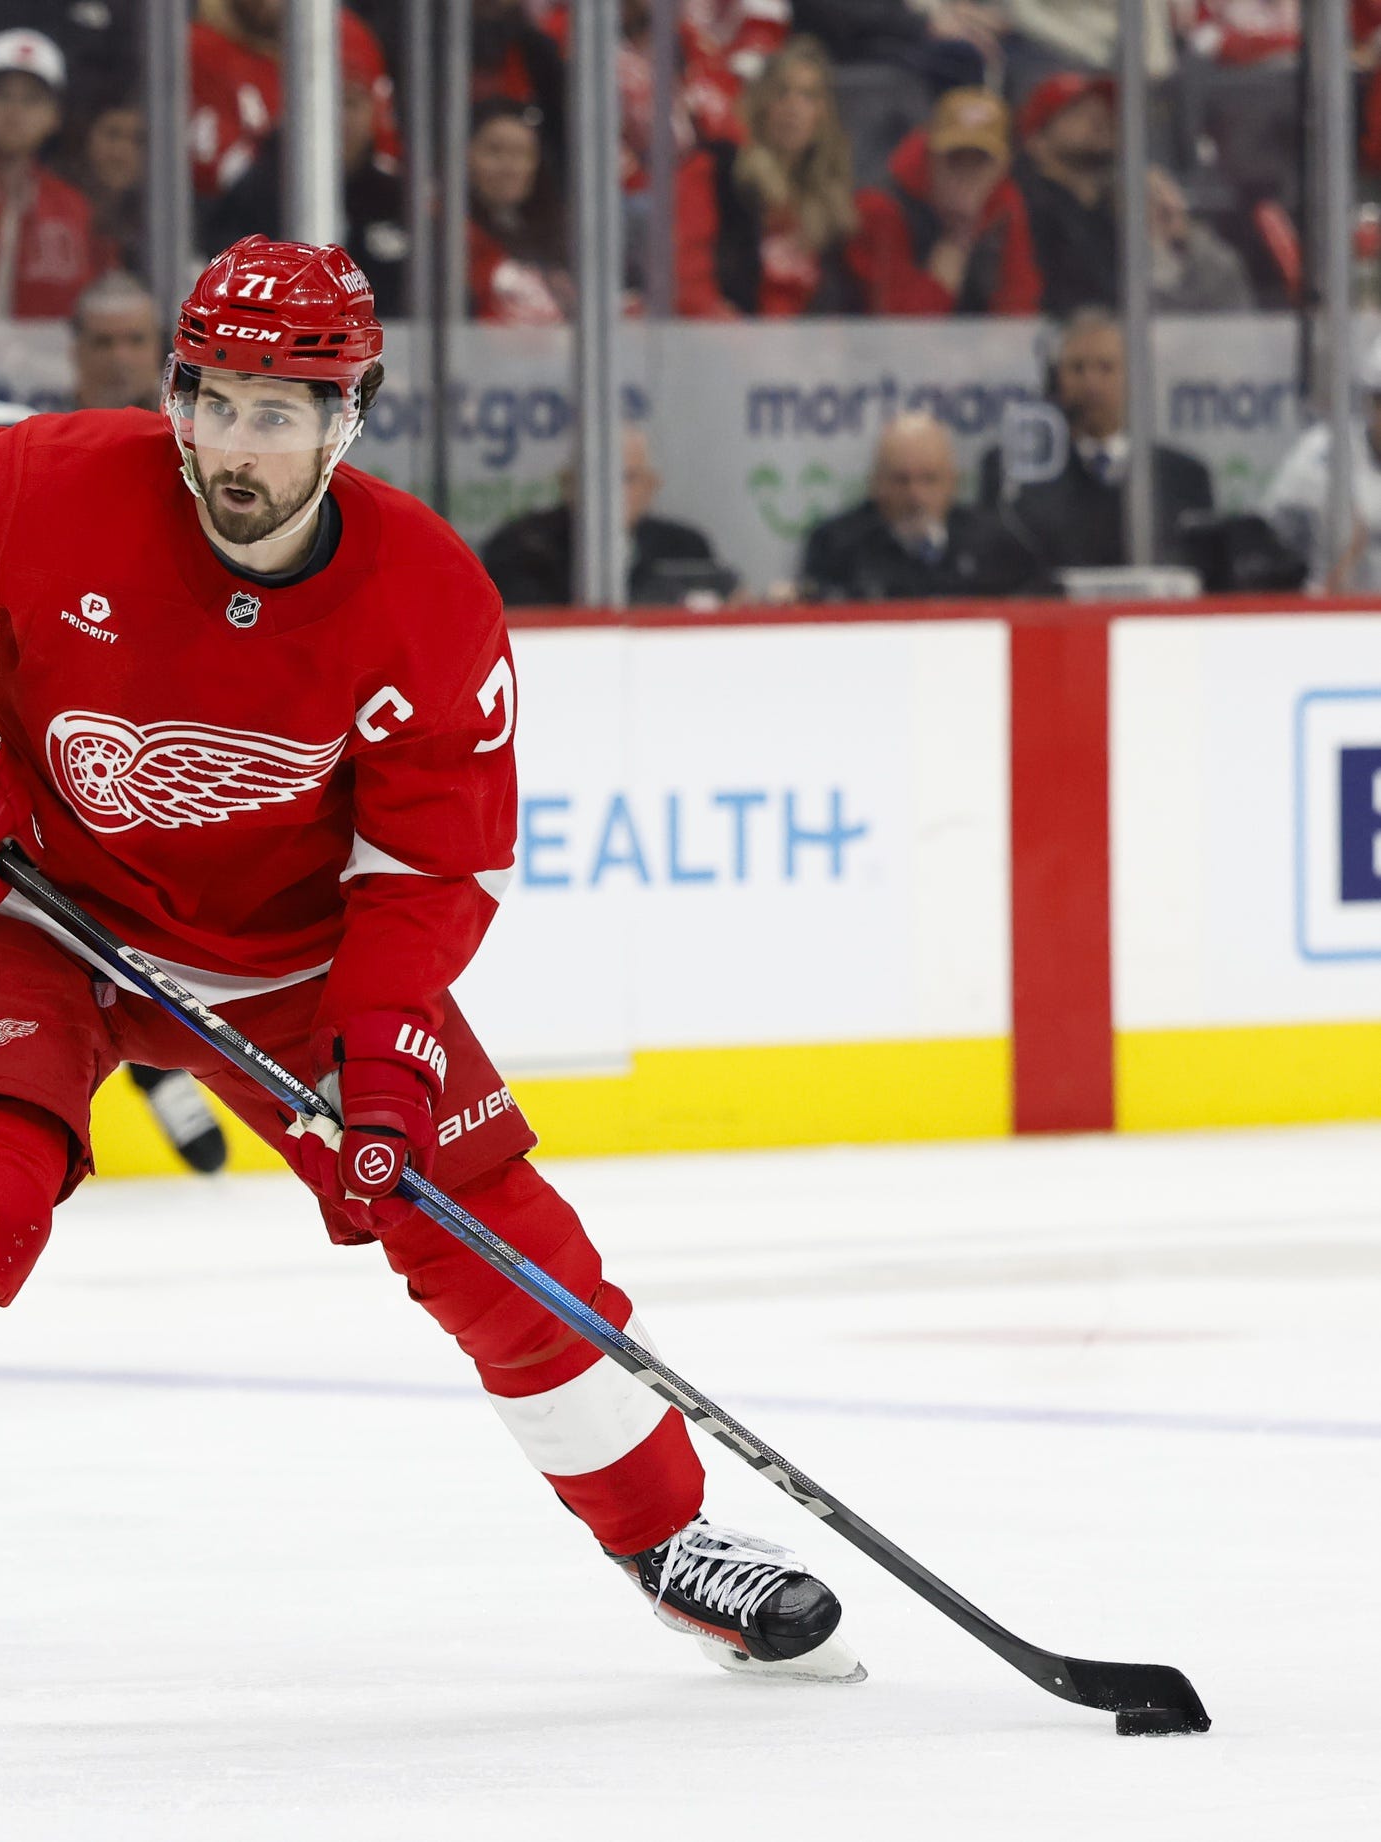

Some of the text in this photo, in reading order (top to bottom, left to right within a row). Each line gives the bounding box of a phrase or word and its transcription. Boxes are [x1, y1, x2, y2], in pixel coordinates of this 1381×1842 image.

[236, 273, 277, 300] 71
[215, 323, 282, 343] CCM
[60, 610, 119, 644] PRIORITY
[231, 604, 255, 620] NHL
[355, 685, 414, 743] C
[255, 1051, 304, 1092] LARKIN
